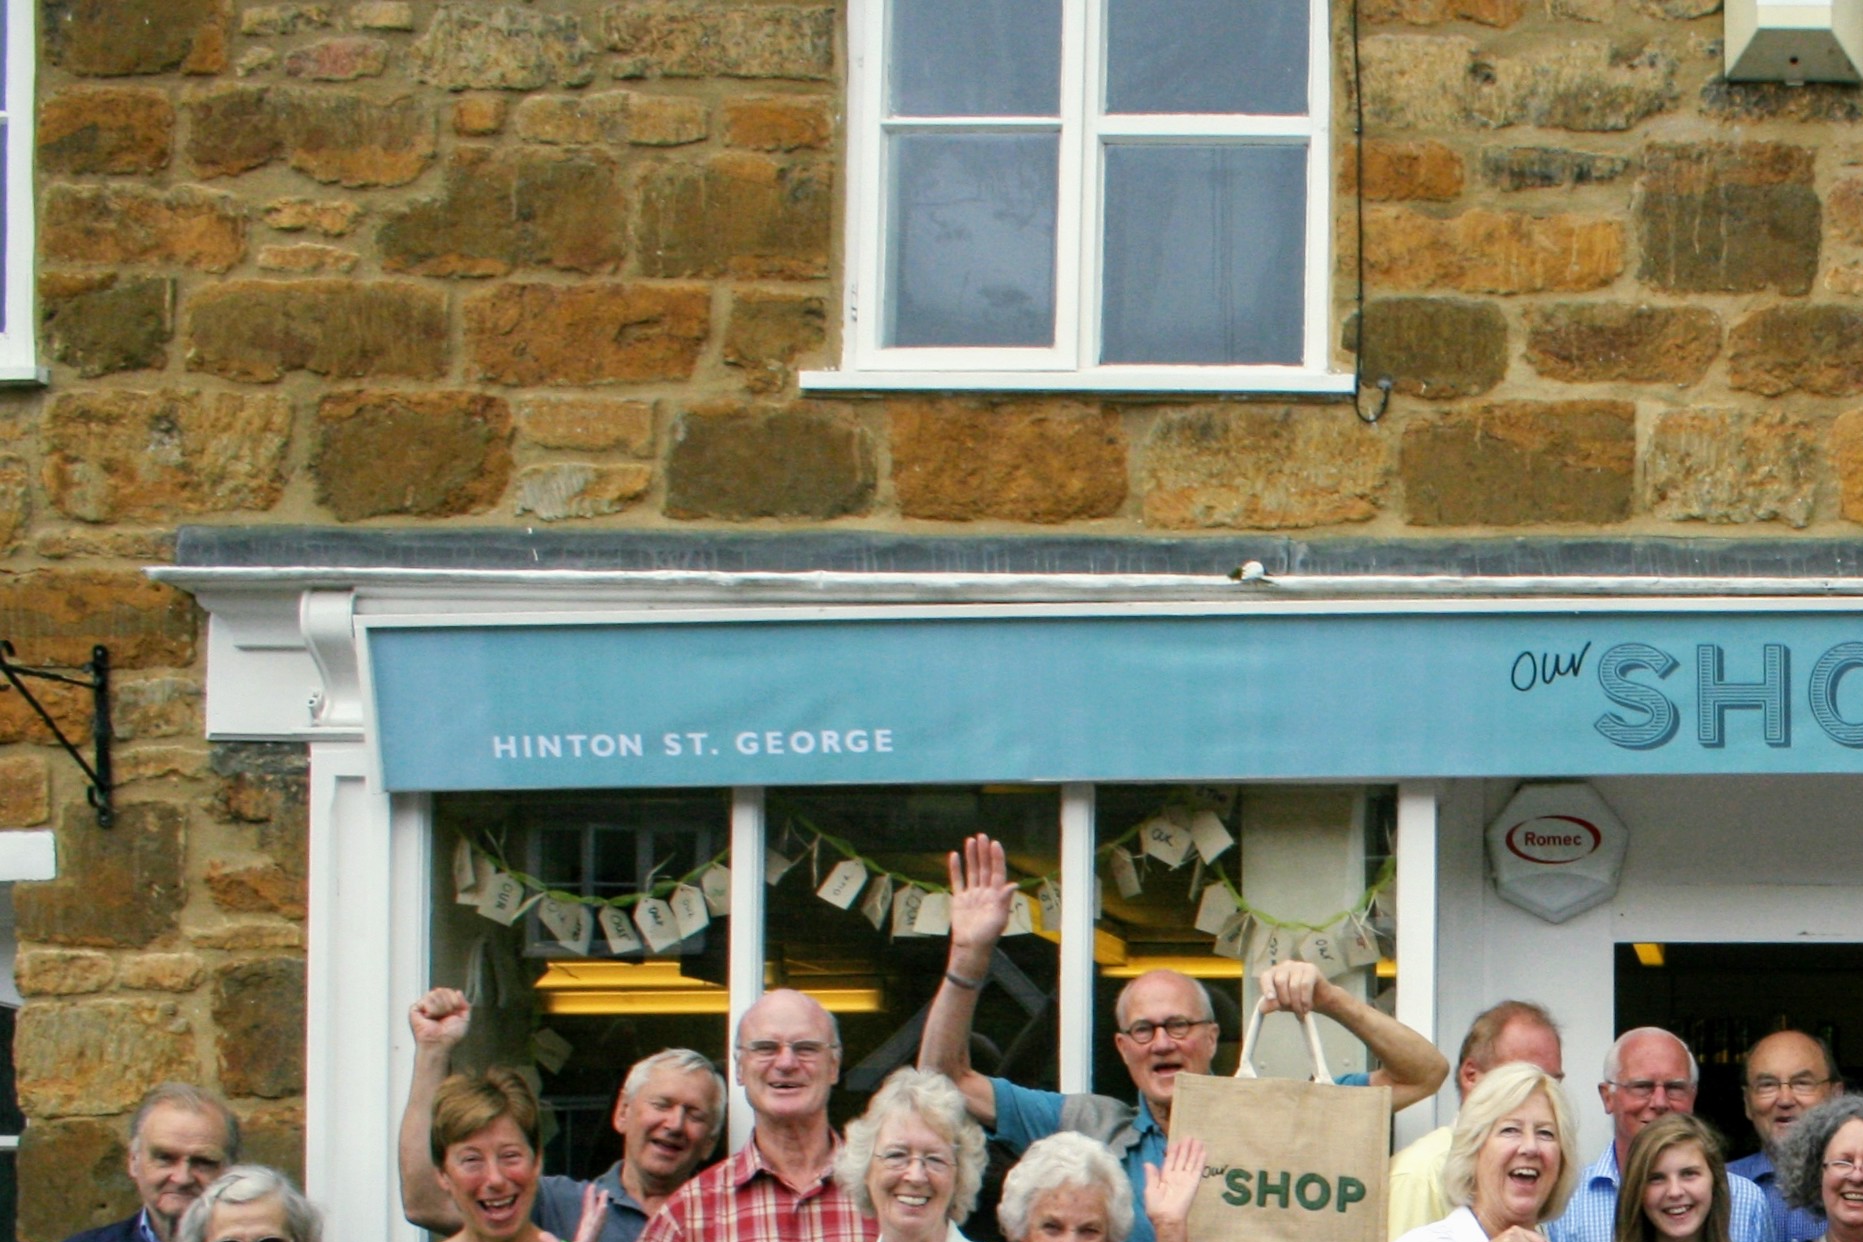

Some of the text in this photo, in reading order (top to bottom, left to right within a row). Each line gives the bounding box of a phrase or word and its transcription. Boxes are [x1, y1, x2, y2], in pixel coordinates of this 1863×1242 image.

[492, 729, 894, 759] HINTON ST. GEORGE
[1524, 830, 1583, 847] Romec
[1221, 1168, 1366, 1213] SHOP
